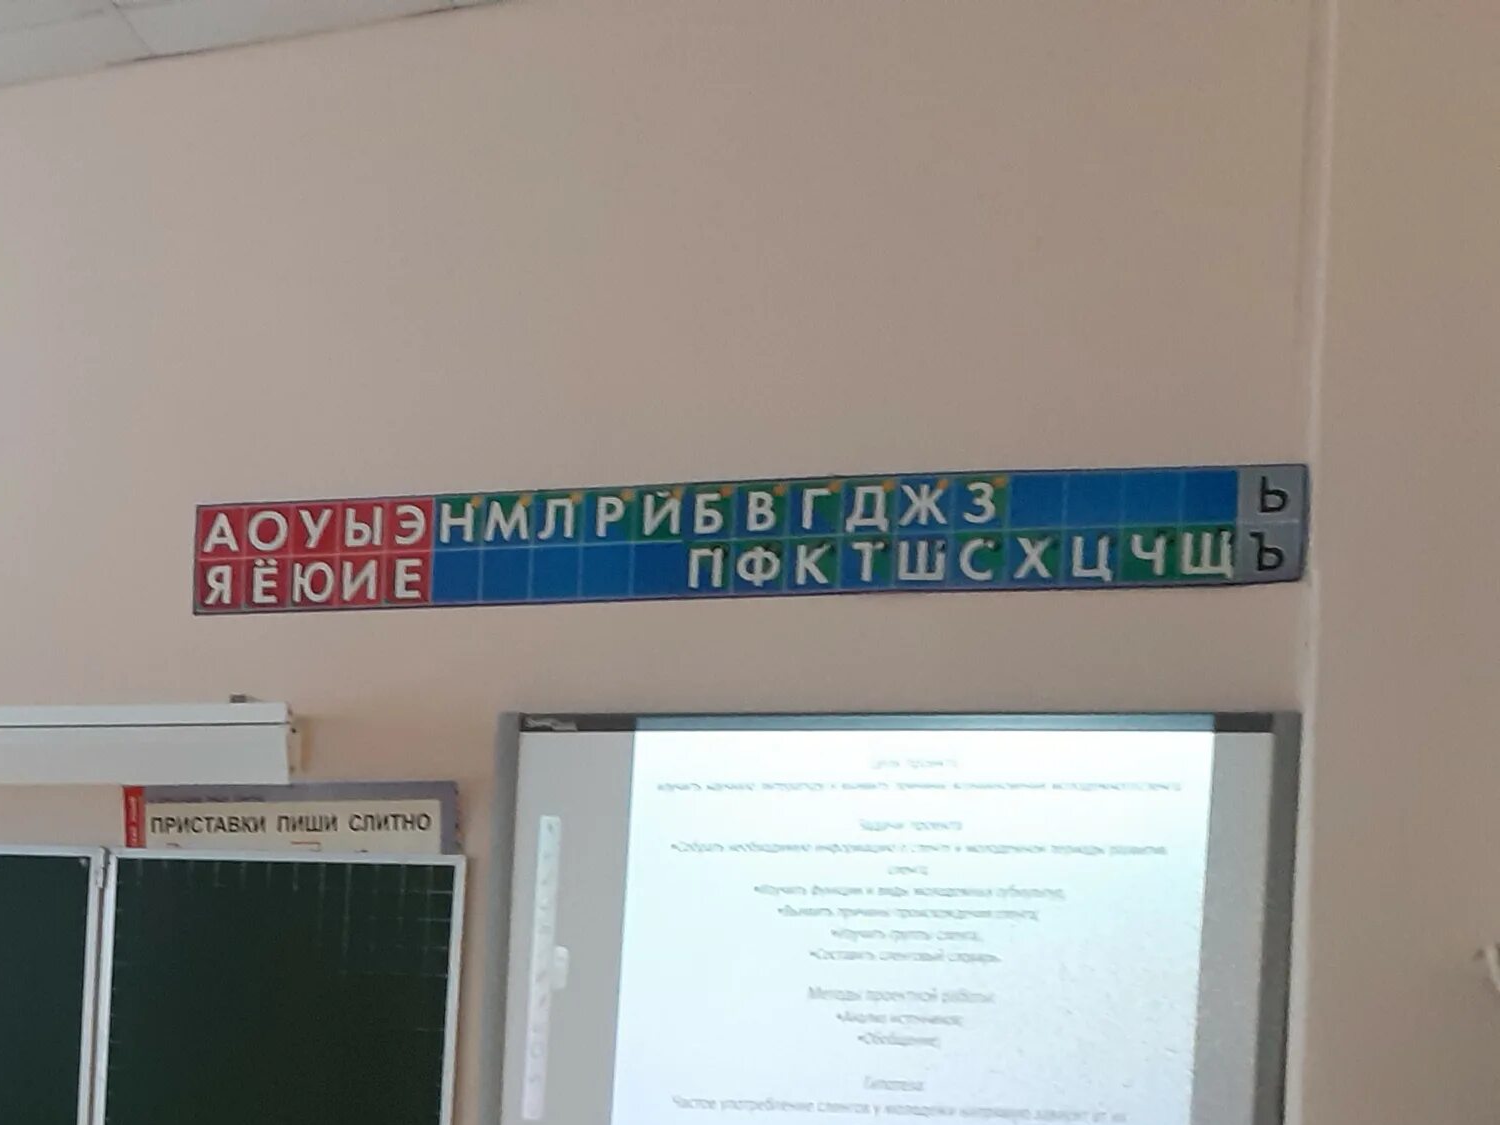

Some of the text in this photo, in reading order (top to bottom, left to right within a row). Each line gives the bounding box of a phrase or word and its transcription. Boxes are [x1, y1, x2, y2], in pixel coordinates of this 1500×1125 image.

[203, 476, 1288, 552] А О У Ы Э Н М Л Р Й Б В Г Д Ж З Ь
[204, 531, 1283, 605] Я Ё Ю И Е П Ф К Т Ш С Х Ц Ч Щ Ъ
[151, 811, 432, 834] ПРИСТАВКИ ПИШИ СЛИТНО
